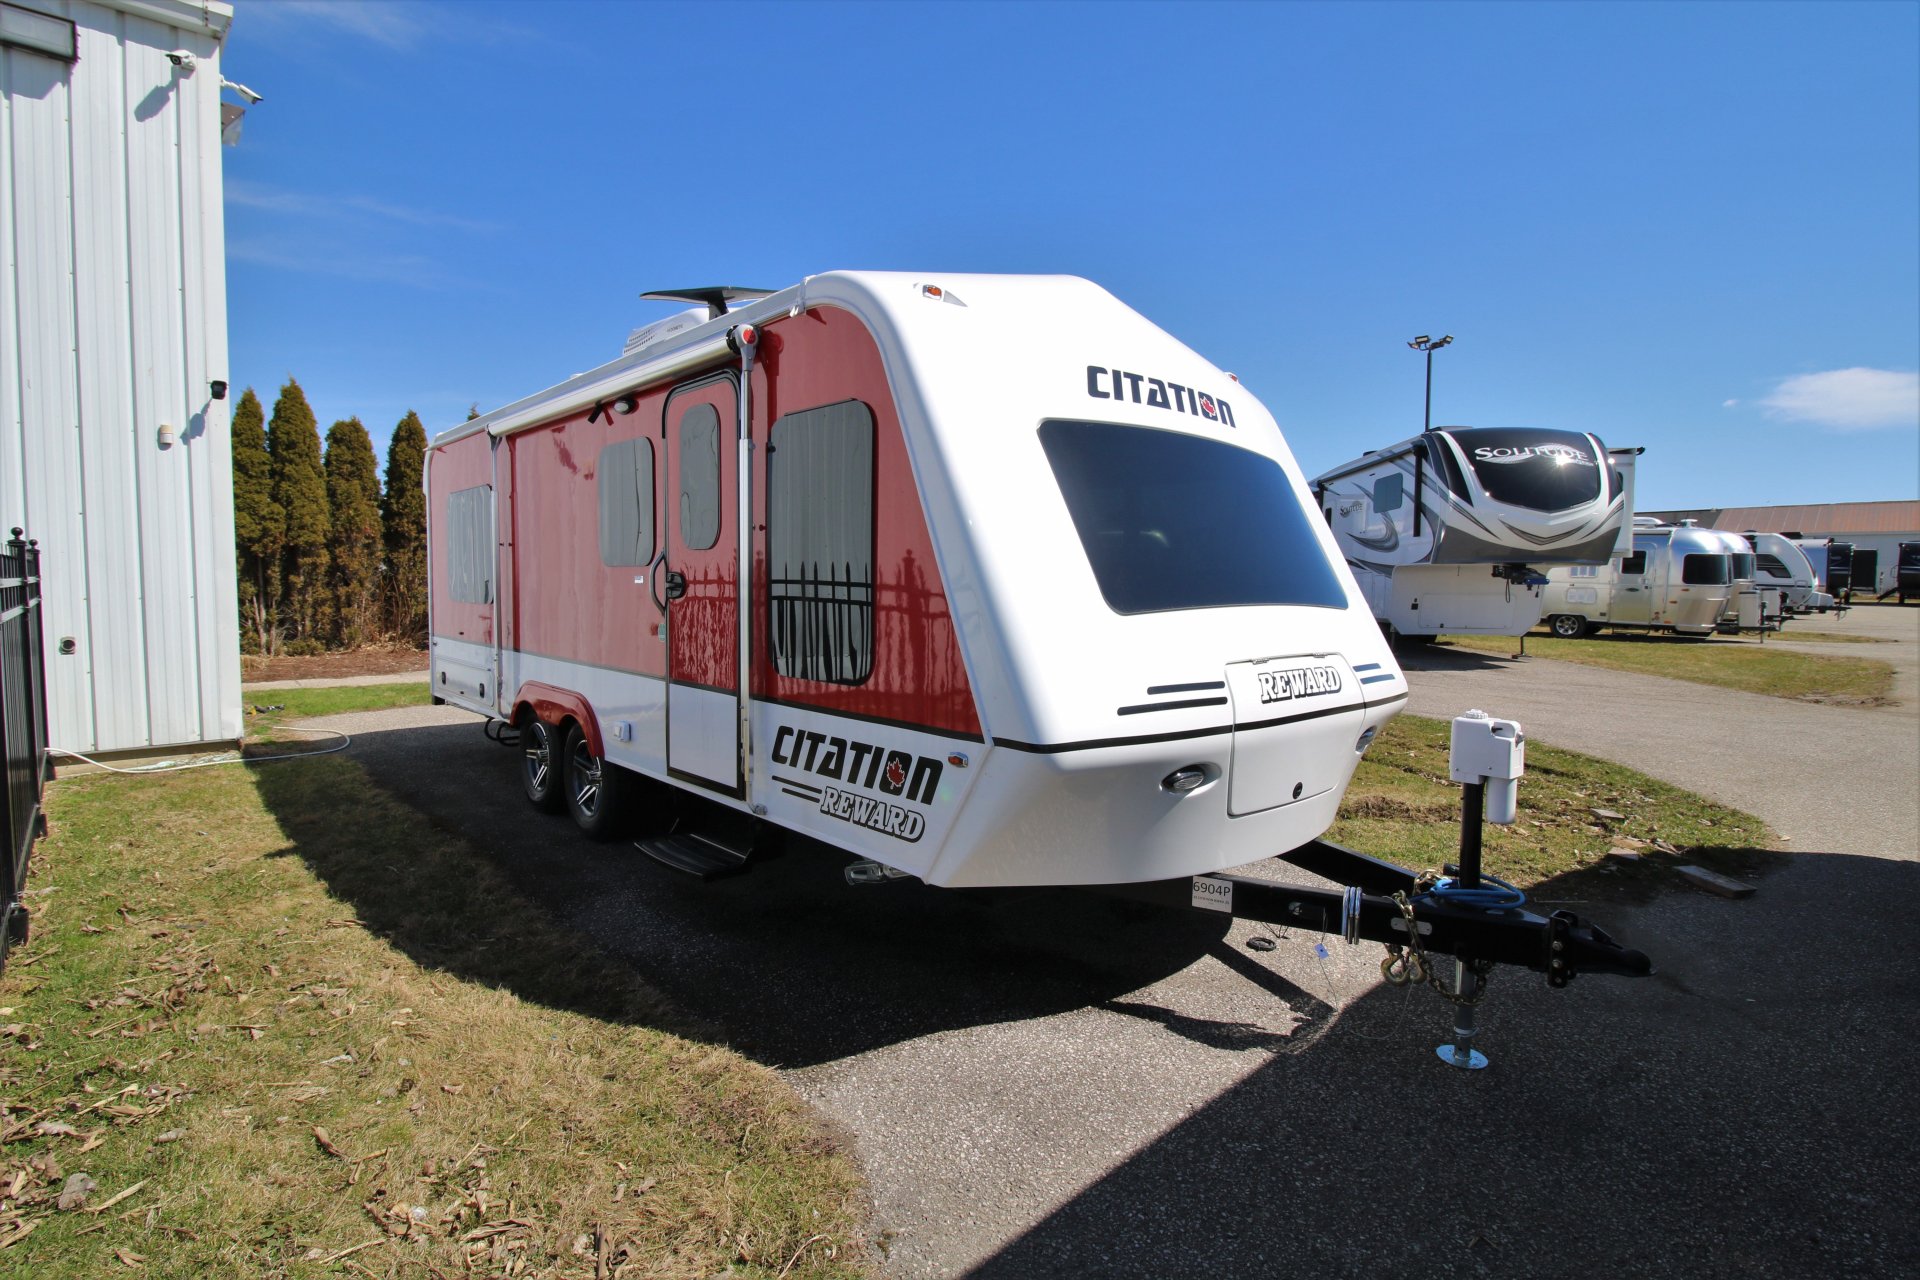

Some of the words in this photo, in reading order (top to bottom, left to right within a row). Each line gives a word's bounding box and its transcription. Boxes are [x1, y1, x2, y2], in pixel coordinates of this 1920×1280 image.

[1086, 365, 1237, 428] CITATION
[1474, 446, 1590, 461] SOLITUDE
[1258, 666, 1342, 704] REWARD
[771, 725, 944, 805] CITATION
[820, 786, 926, 843] REWARD
[1193, 881, 1231, 896] 6904P
